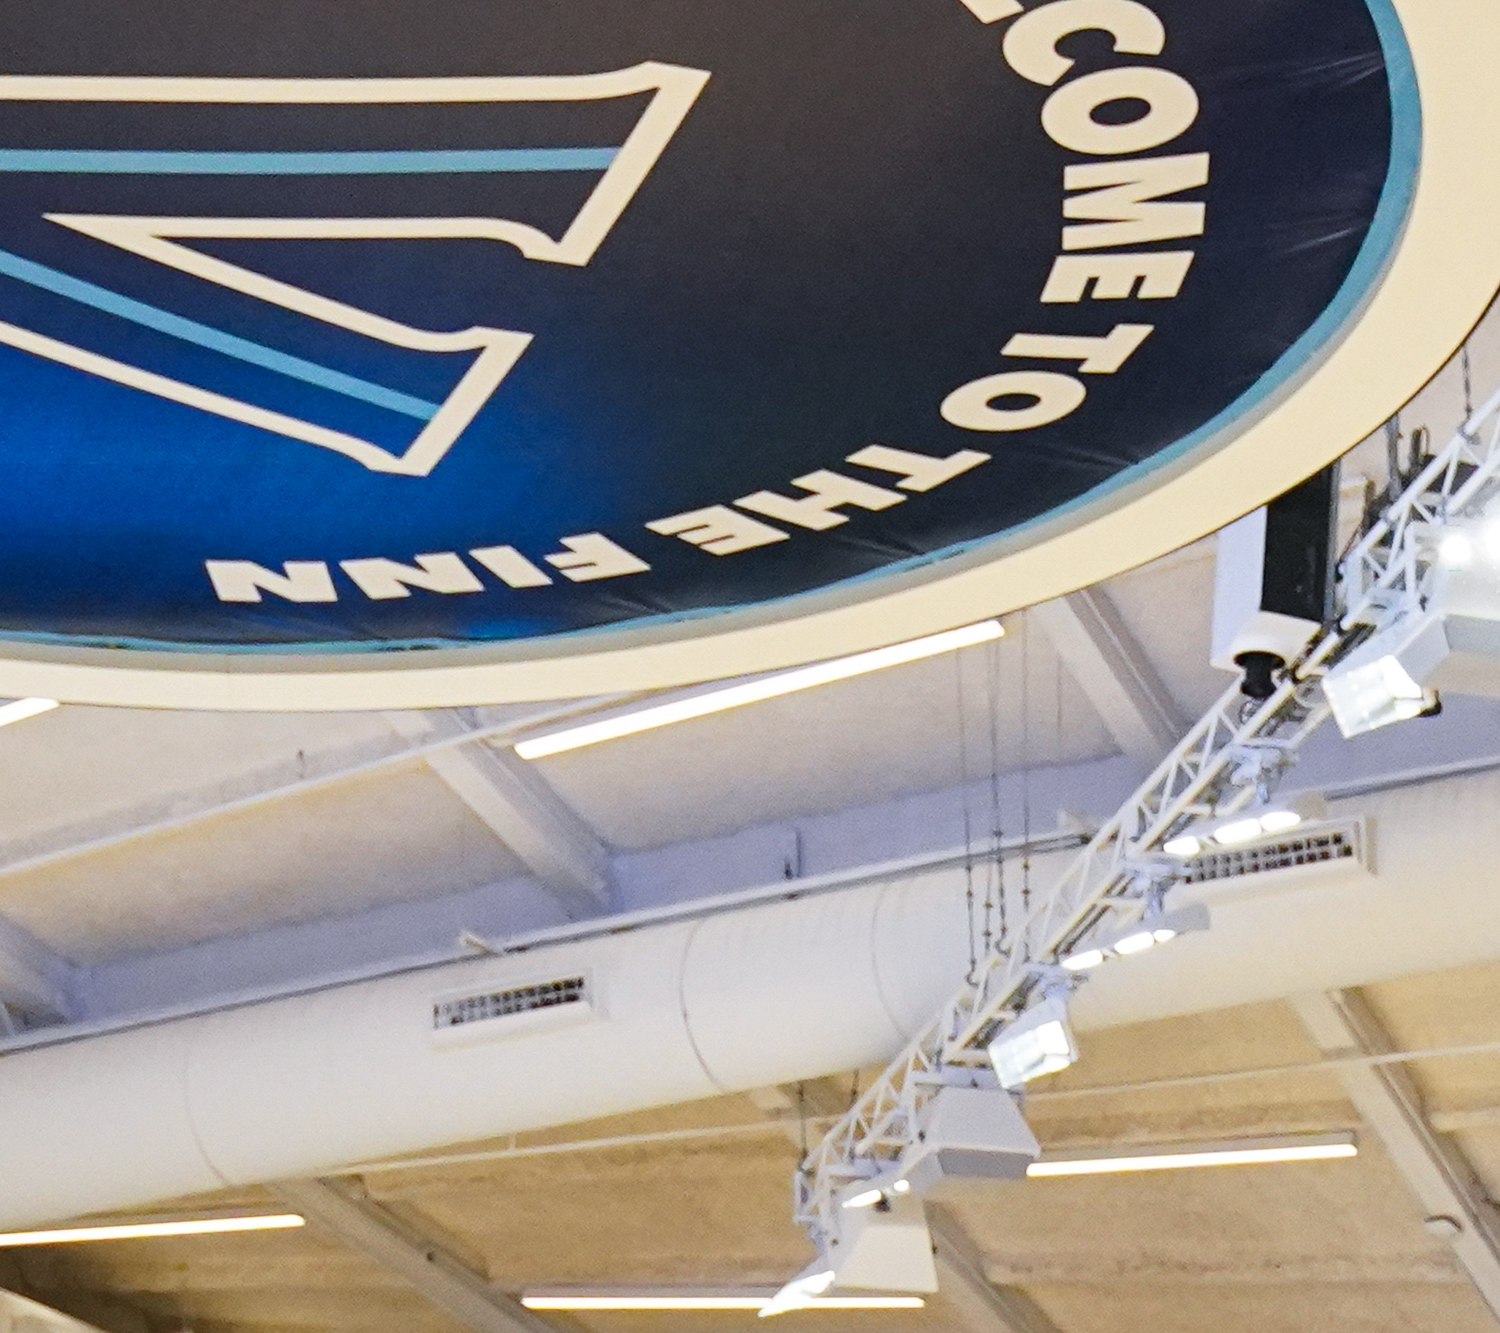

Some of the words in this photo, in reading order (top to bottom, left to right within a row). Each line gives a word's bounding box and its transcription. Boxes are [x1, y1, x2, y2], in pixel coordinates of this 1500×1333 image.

[941, 324, 1153, 431] TO
[646, 445, 991, 556] THE
[205, 532, 650, 603] FINN
